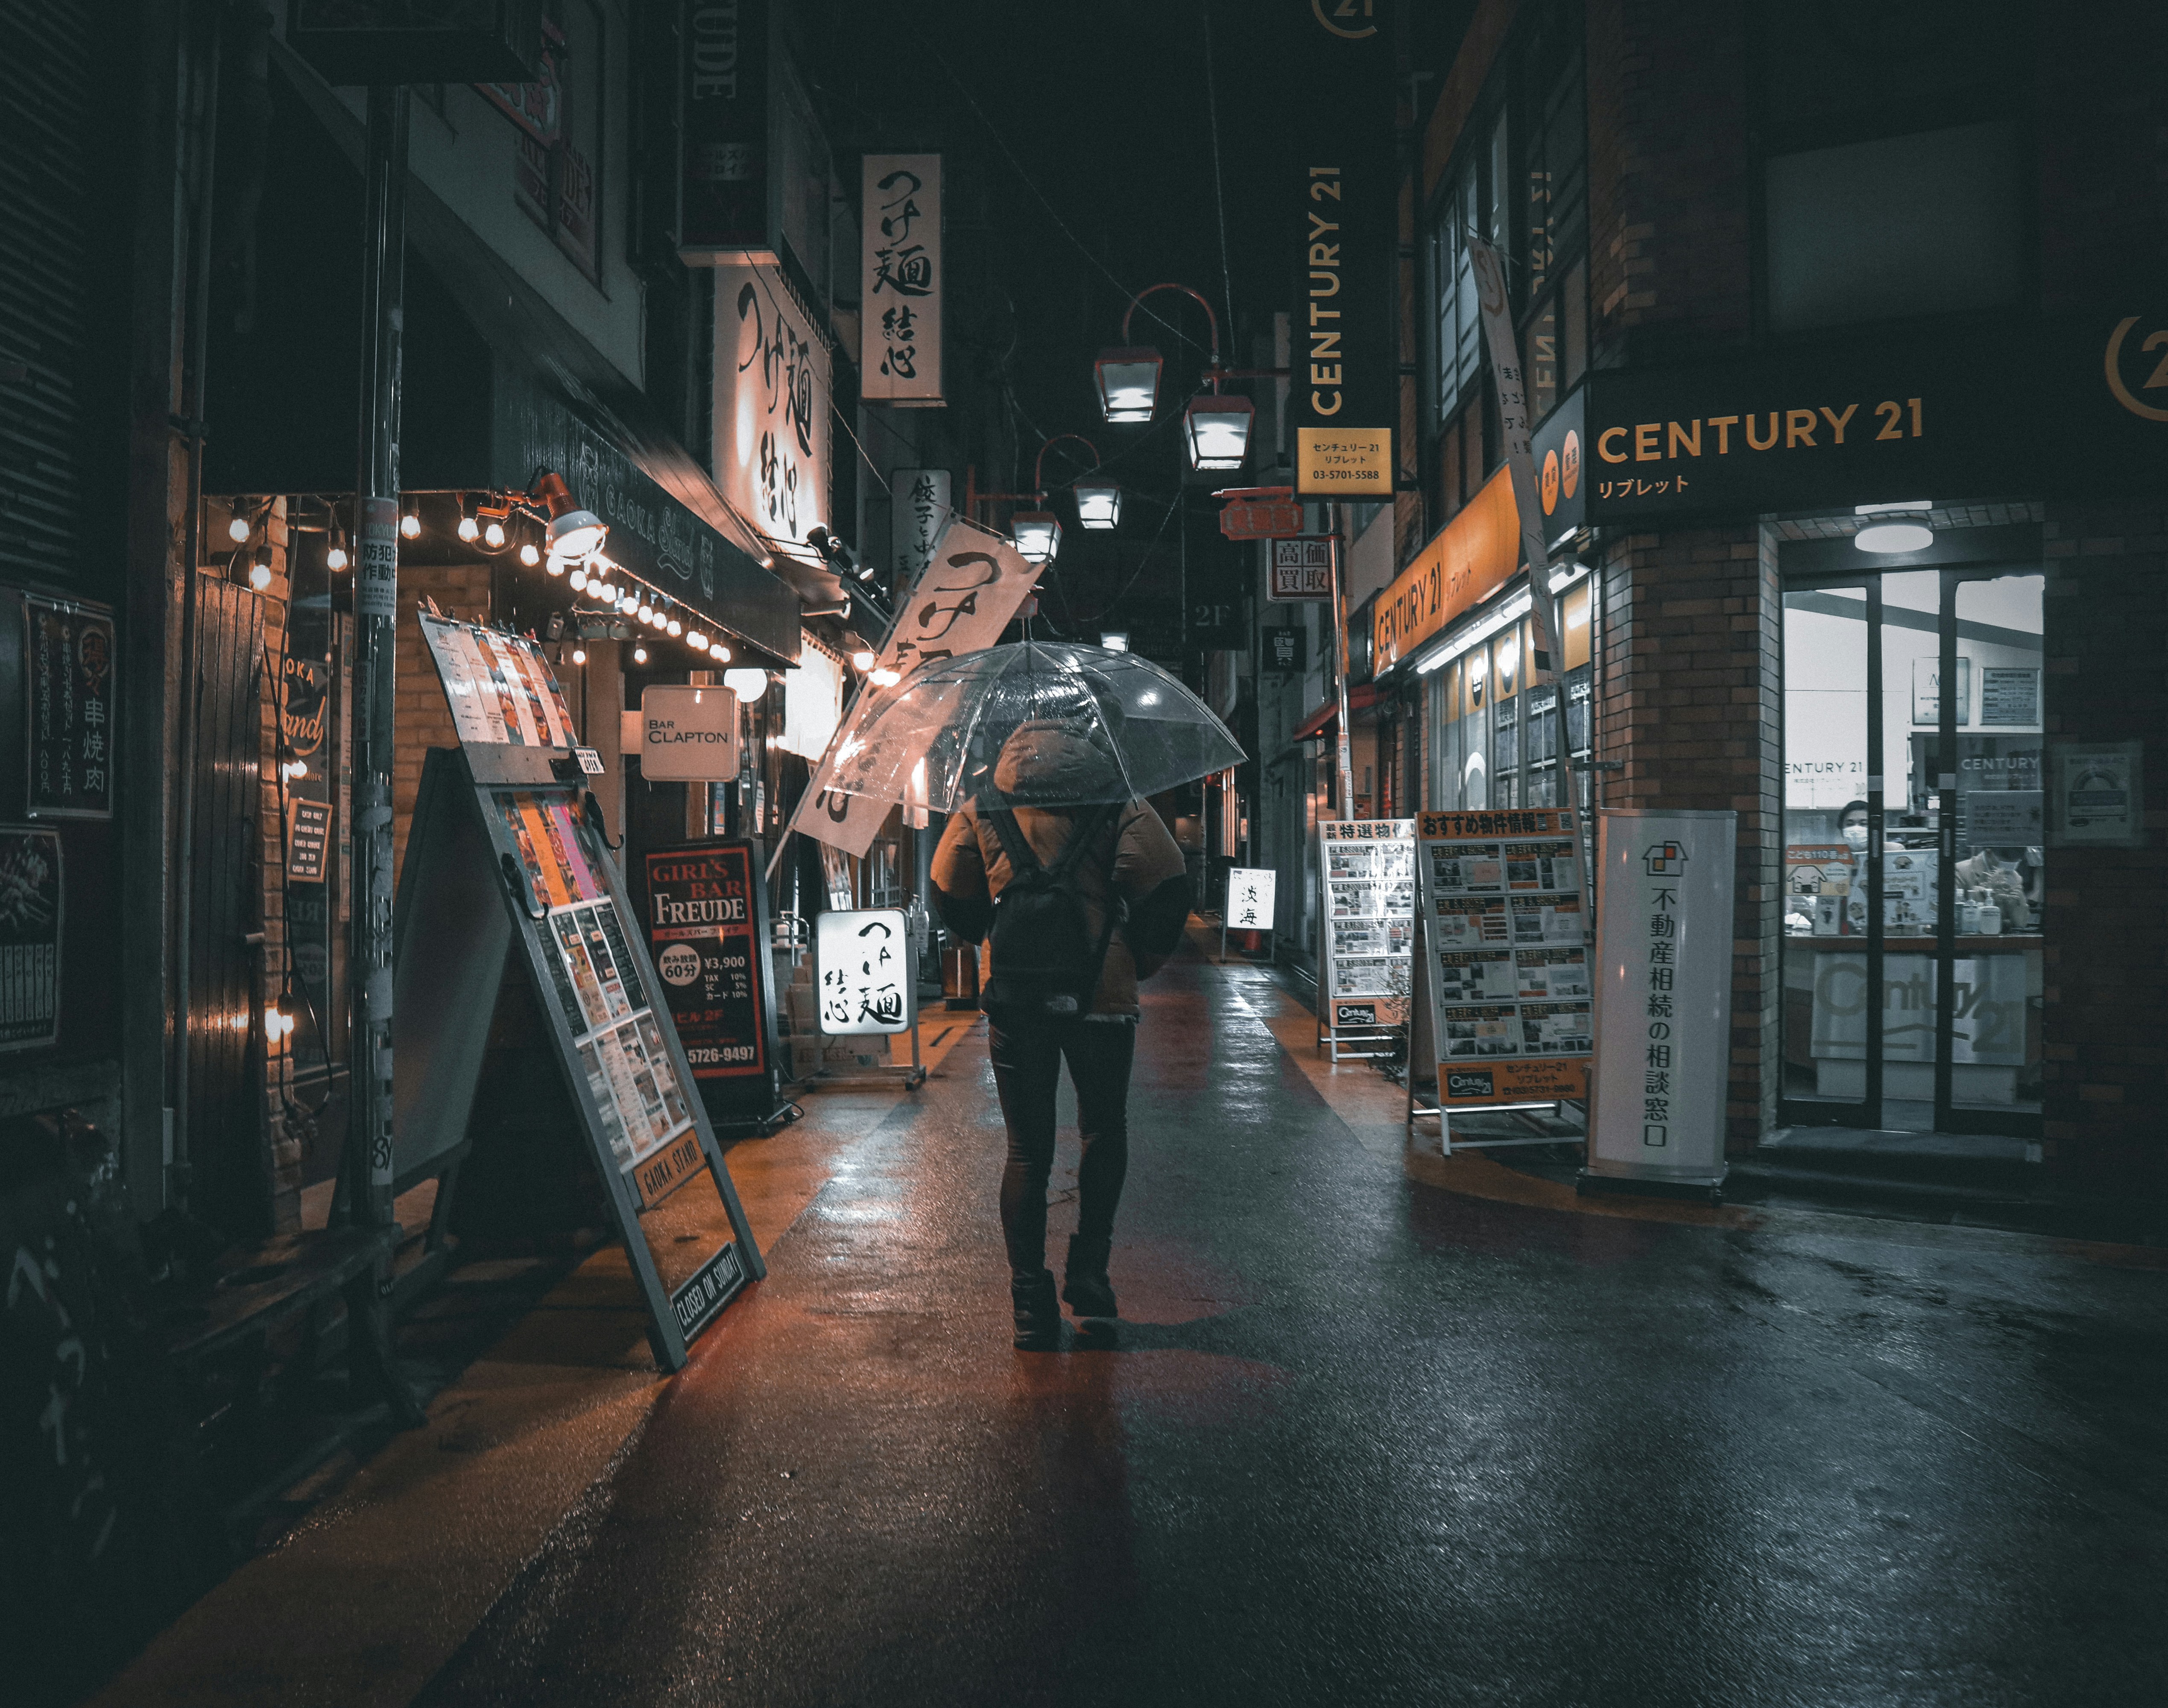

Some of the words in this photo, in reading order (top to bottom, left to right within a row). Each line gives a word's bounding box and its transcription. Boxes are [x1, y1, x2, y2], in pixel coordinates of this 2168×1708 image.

[693, 0, 737, 99] UDE
[1309, 167, 1341, 201] 21
[1308, 211, 1342, 416] CENTURY
[1597, 404, 1859, 464] CENTURY
[1875, 398, 1923, 440] 21
[1325, 456, 1366, 464] リブレット
[1313, 470, 1379, 480] 03-5701-5588
[1599, 475, 1689, 499] リブレット
[1279, 544, 1325, 564] 高価
[1279, 569, 1325, 590] 買取
[1378, 575, 1427, 655] CENTURY
[1430, 562, 1441, 616] 21
[83, 698, 105, 793] 串焼肉
[1785, 762, 1844, 773] ENTURY
[1961, 757, 2039, 770] CENTURY
[1423, 812, 1536, 836] おすすめ物件情報
[652, 858, 729, 882] GIRL'S
[691, 880, 743, 898] BAR
[655, 892, 745, 925] FREUDE
[664, 954, 697, 964] 飲み放題
[665, 963, 696, 978] 60分
[704, 956, 745, 970] ¥3,900
[704, 974, 719, 983] TAX
[1644, 888, 1677, 1146] 不動産相続の相談窓口
[688, 1047, 754, 1064] 5726-9497
[644, 1161, 672, 1196] GAOKA
[673, 1140, 699, 1173] STAND
[676, 1284, 705, 1326] CLOSED
[702, 1277, 716, 1299] ON
[713, 1248, 739, 1290] SUNDAY
